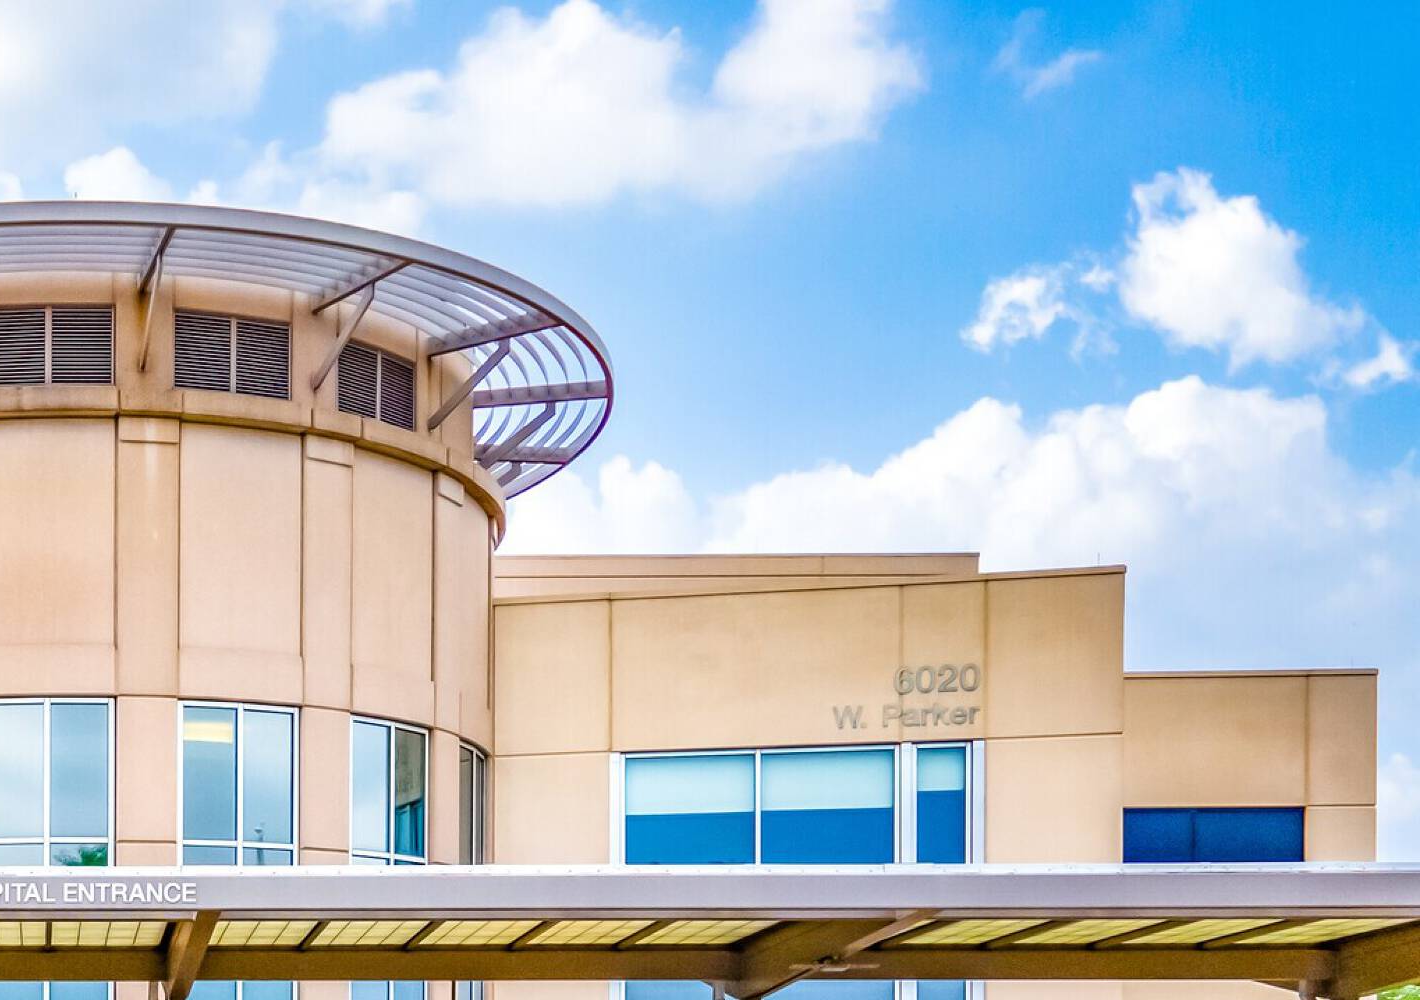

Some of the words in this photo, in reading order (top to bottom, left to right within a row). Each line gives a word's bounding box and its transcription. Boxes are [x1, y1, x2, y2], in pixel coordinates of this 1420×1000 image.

[893, 663, 981, 695] 6020
[833, 704, 867, 729] W.
[882, 702, 981, 728] Parker
[63, 882, 198, 904] ENTRANCE
